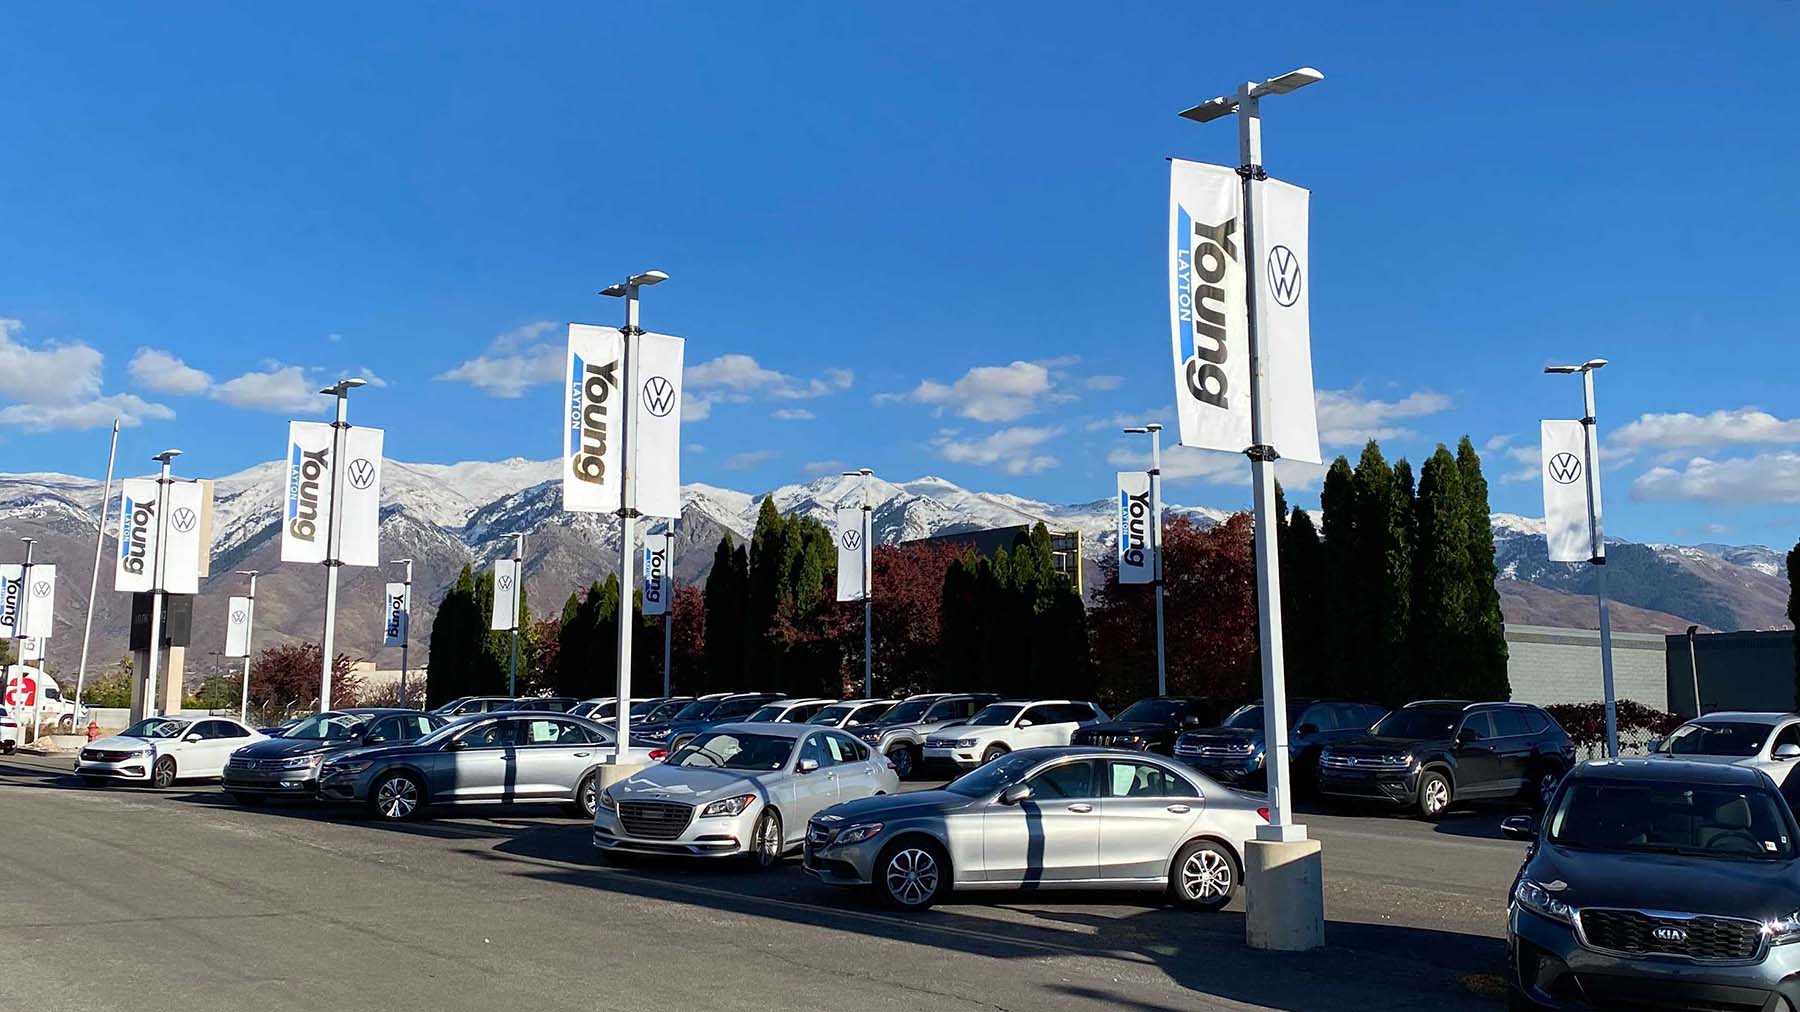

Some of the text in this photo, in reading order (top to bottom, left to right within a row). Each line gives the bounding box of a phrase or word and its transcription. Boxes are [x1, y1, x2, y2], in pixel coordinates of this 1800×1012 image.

[1178, 249, 1191, 322] LAYTON
[1186, 216, 1238, 410] Young
[571, 382, 582, 430] LAYTON
[572, 359, 618, 485] Young
[290, 464, 300, 500] LAYTON
[290, 447, 329, 542] Young
[123, 499, 156, 575] Young
[1124, 491, 1150, 567] Young
[1, 576, 22, 627] Young
[646, 548, 665, 603] Young
[388, 594, 403, 637] Young
[1658, 929, 1681, 940] KIA
